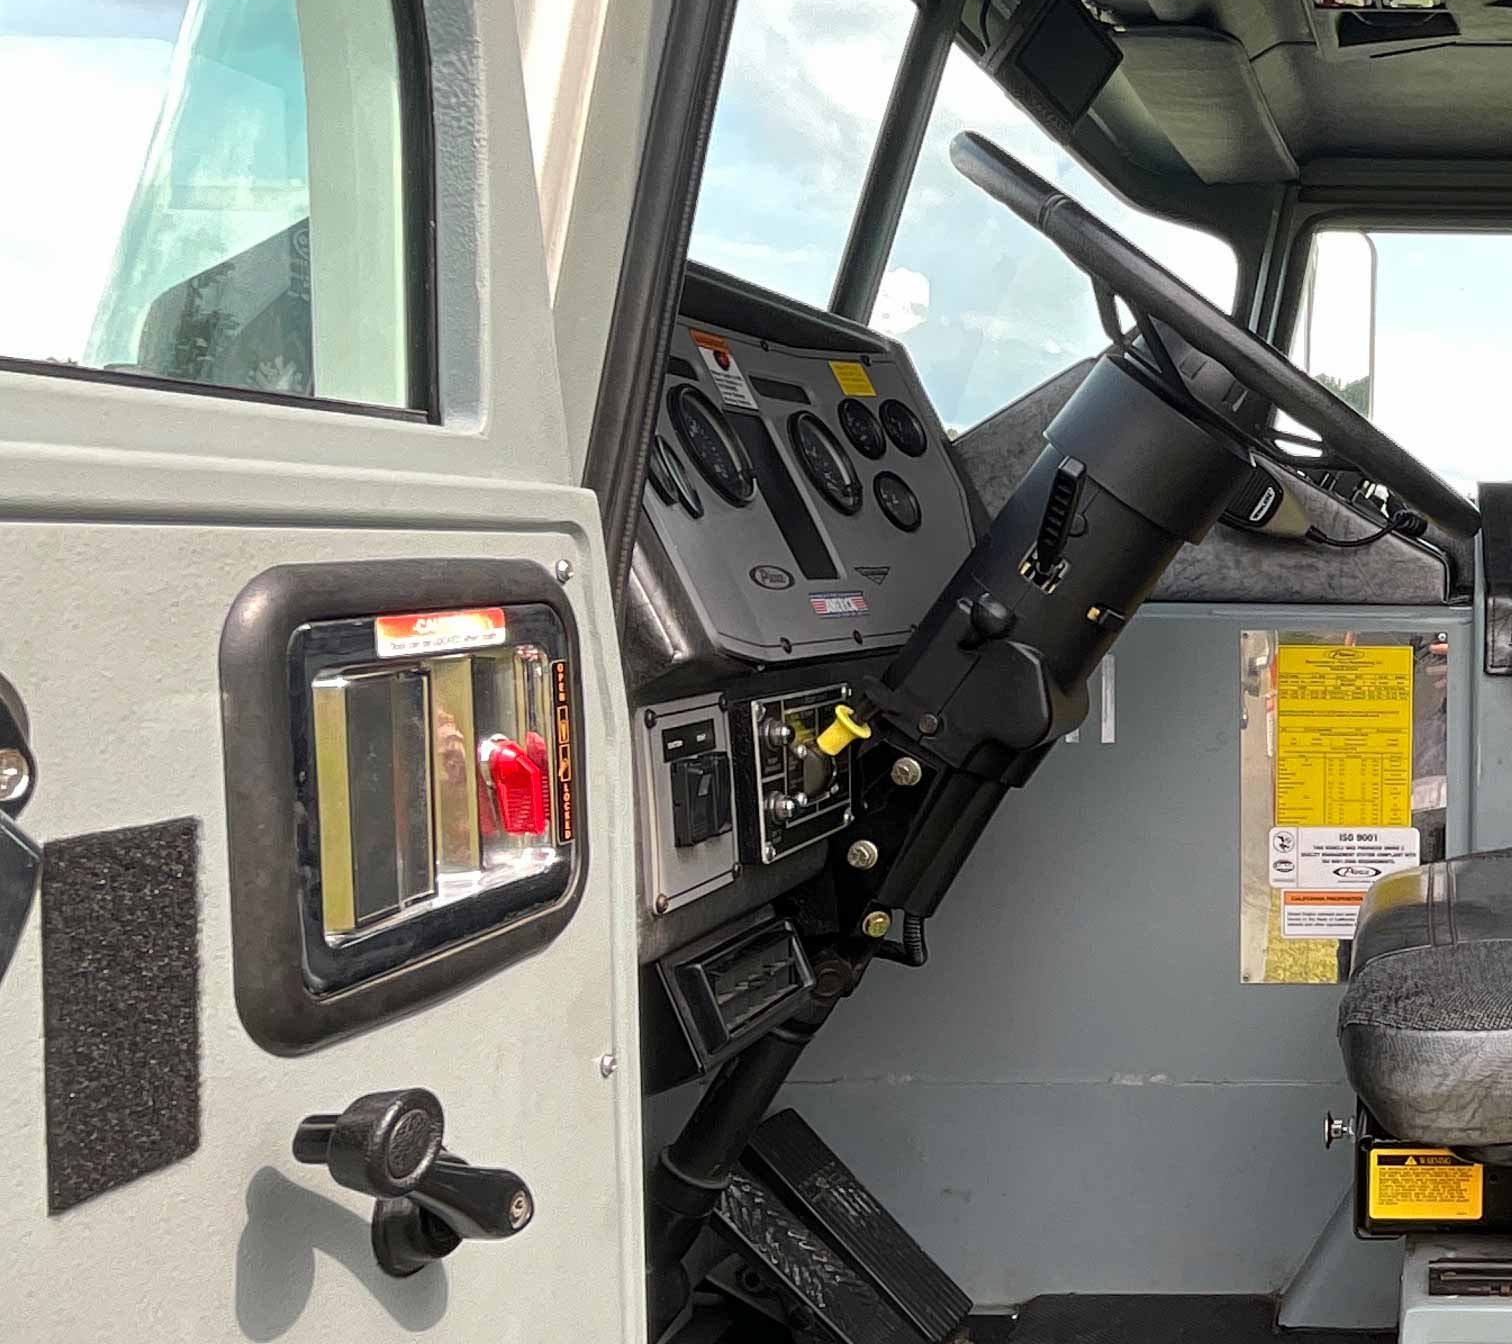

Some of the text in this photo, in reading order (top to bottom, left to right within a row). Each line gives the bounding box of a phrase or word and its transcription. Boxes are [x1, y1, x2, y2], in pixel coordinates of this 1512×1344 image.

[556, 662, 567, 703] OPEN
[562, 783, 573, 840] LOCKED
[1339, 833, 1378, 842] ISO 9001
